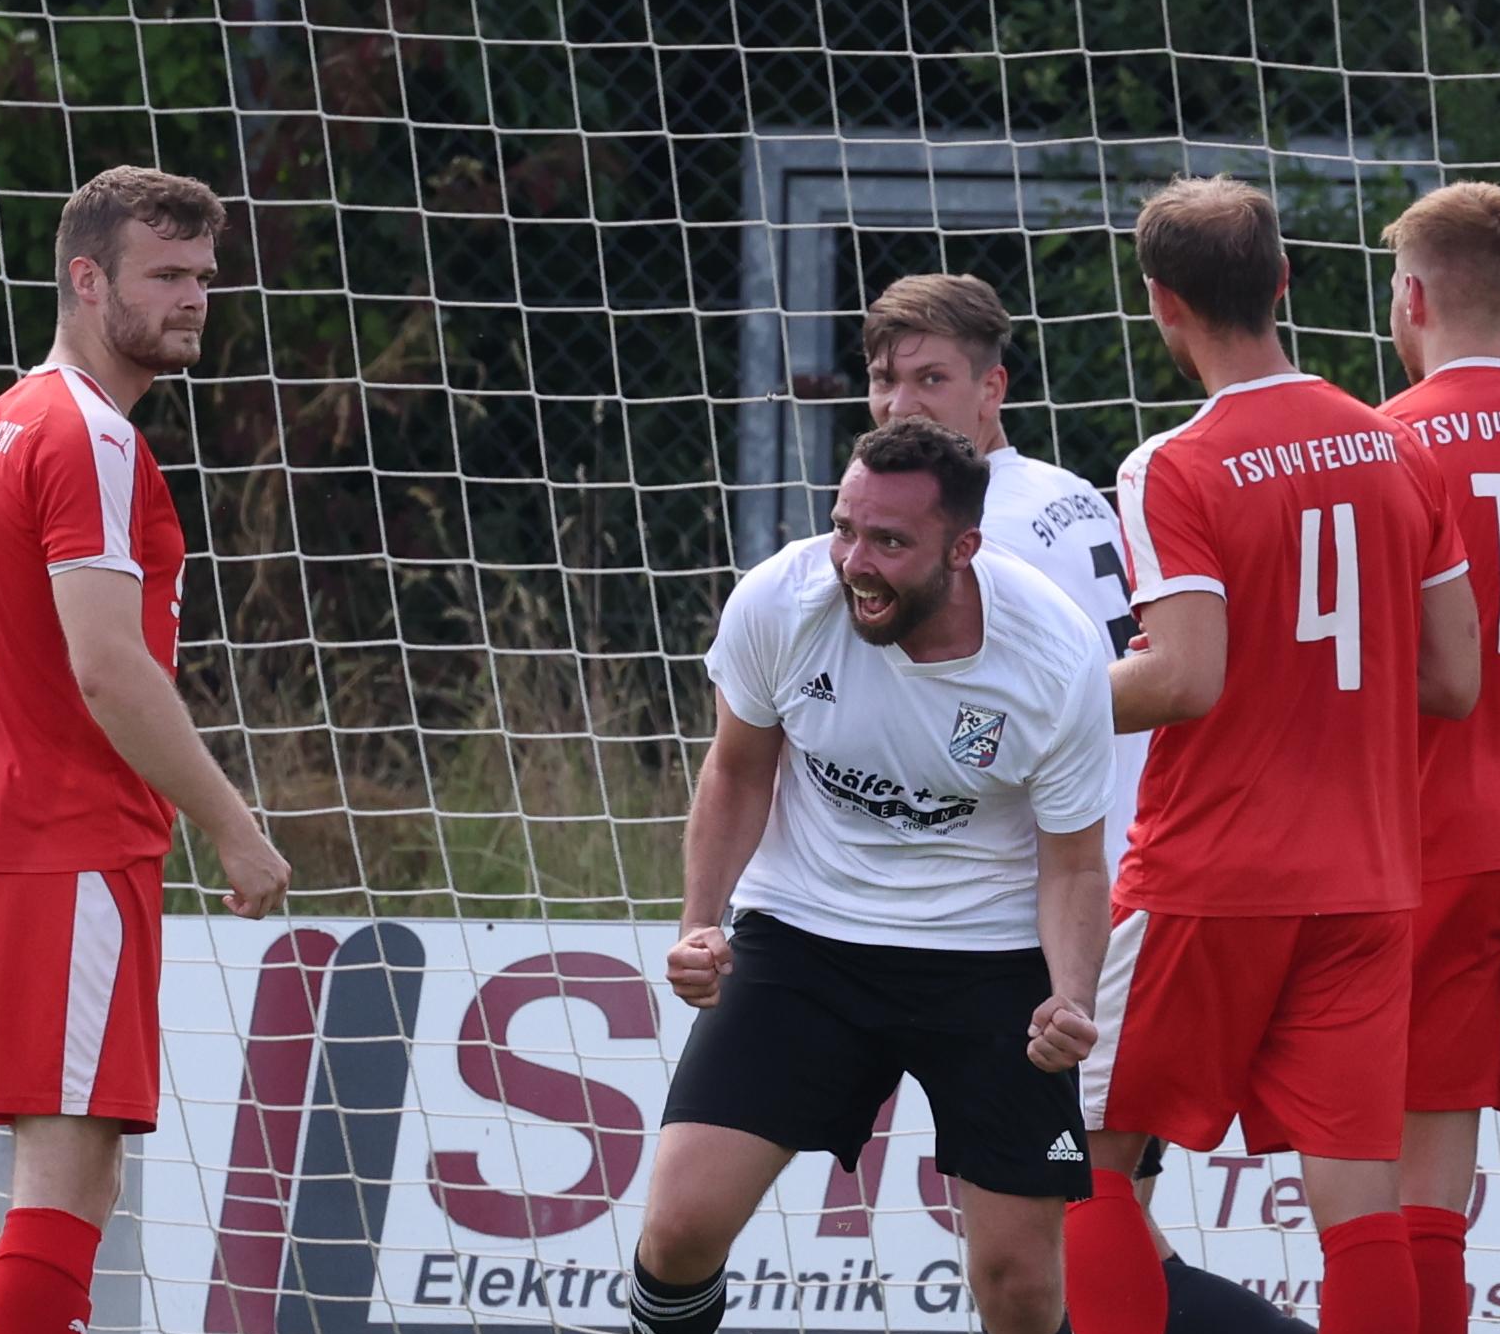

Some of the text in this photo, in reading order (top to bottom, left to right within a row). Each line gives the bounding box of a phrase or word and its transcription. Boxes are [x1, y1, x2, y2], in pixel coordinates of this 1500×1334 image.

[1222, 430, 1398, 487] TSV 04 FEUCHT
[1413, 412, 1470, 448] TSV
[1295, 502, 1362, 691] 4
[801, 685, 836, 704] adidas
[1047, 1149, 1084, 1162] adidas
[1199, 1156, 1307, 1230] Te
[413, 1252, 895, 1313] Elektrochnik
